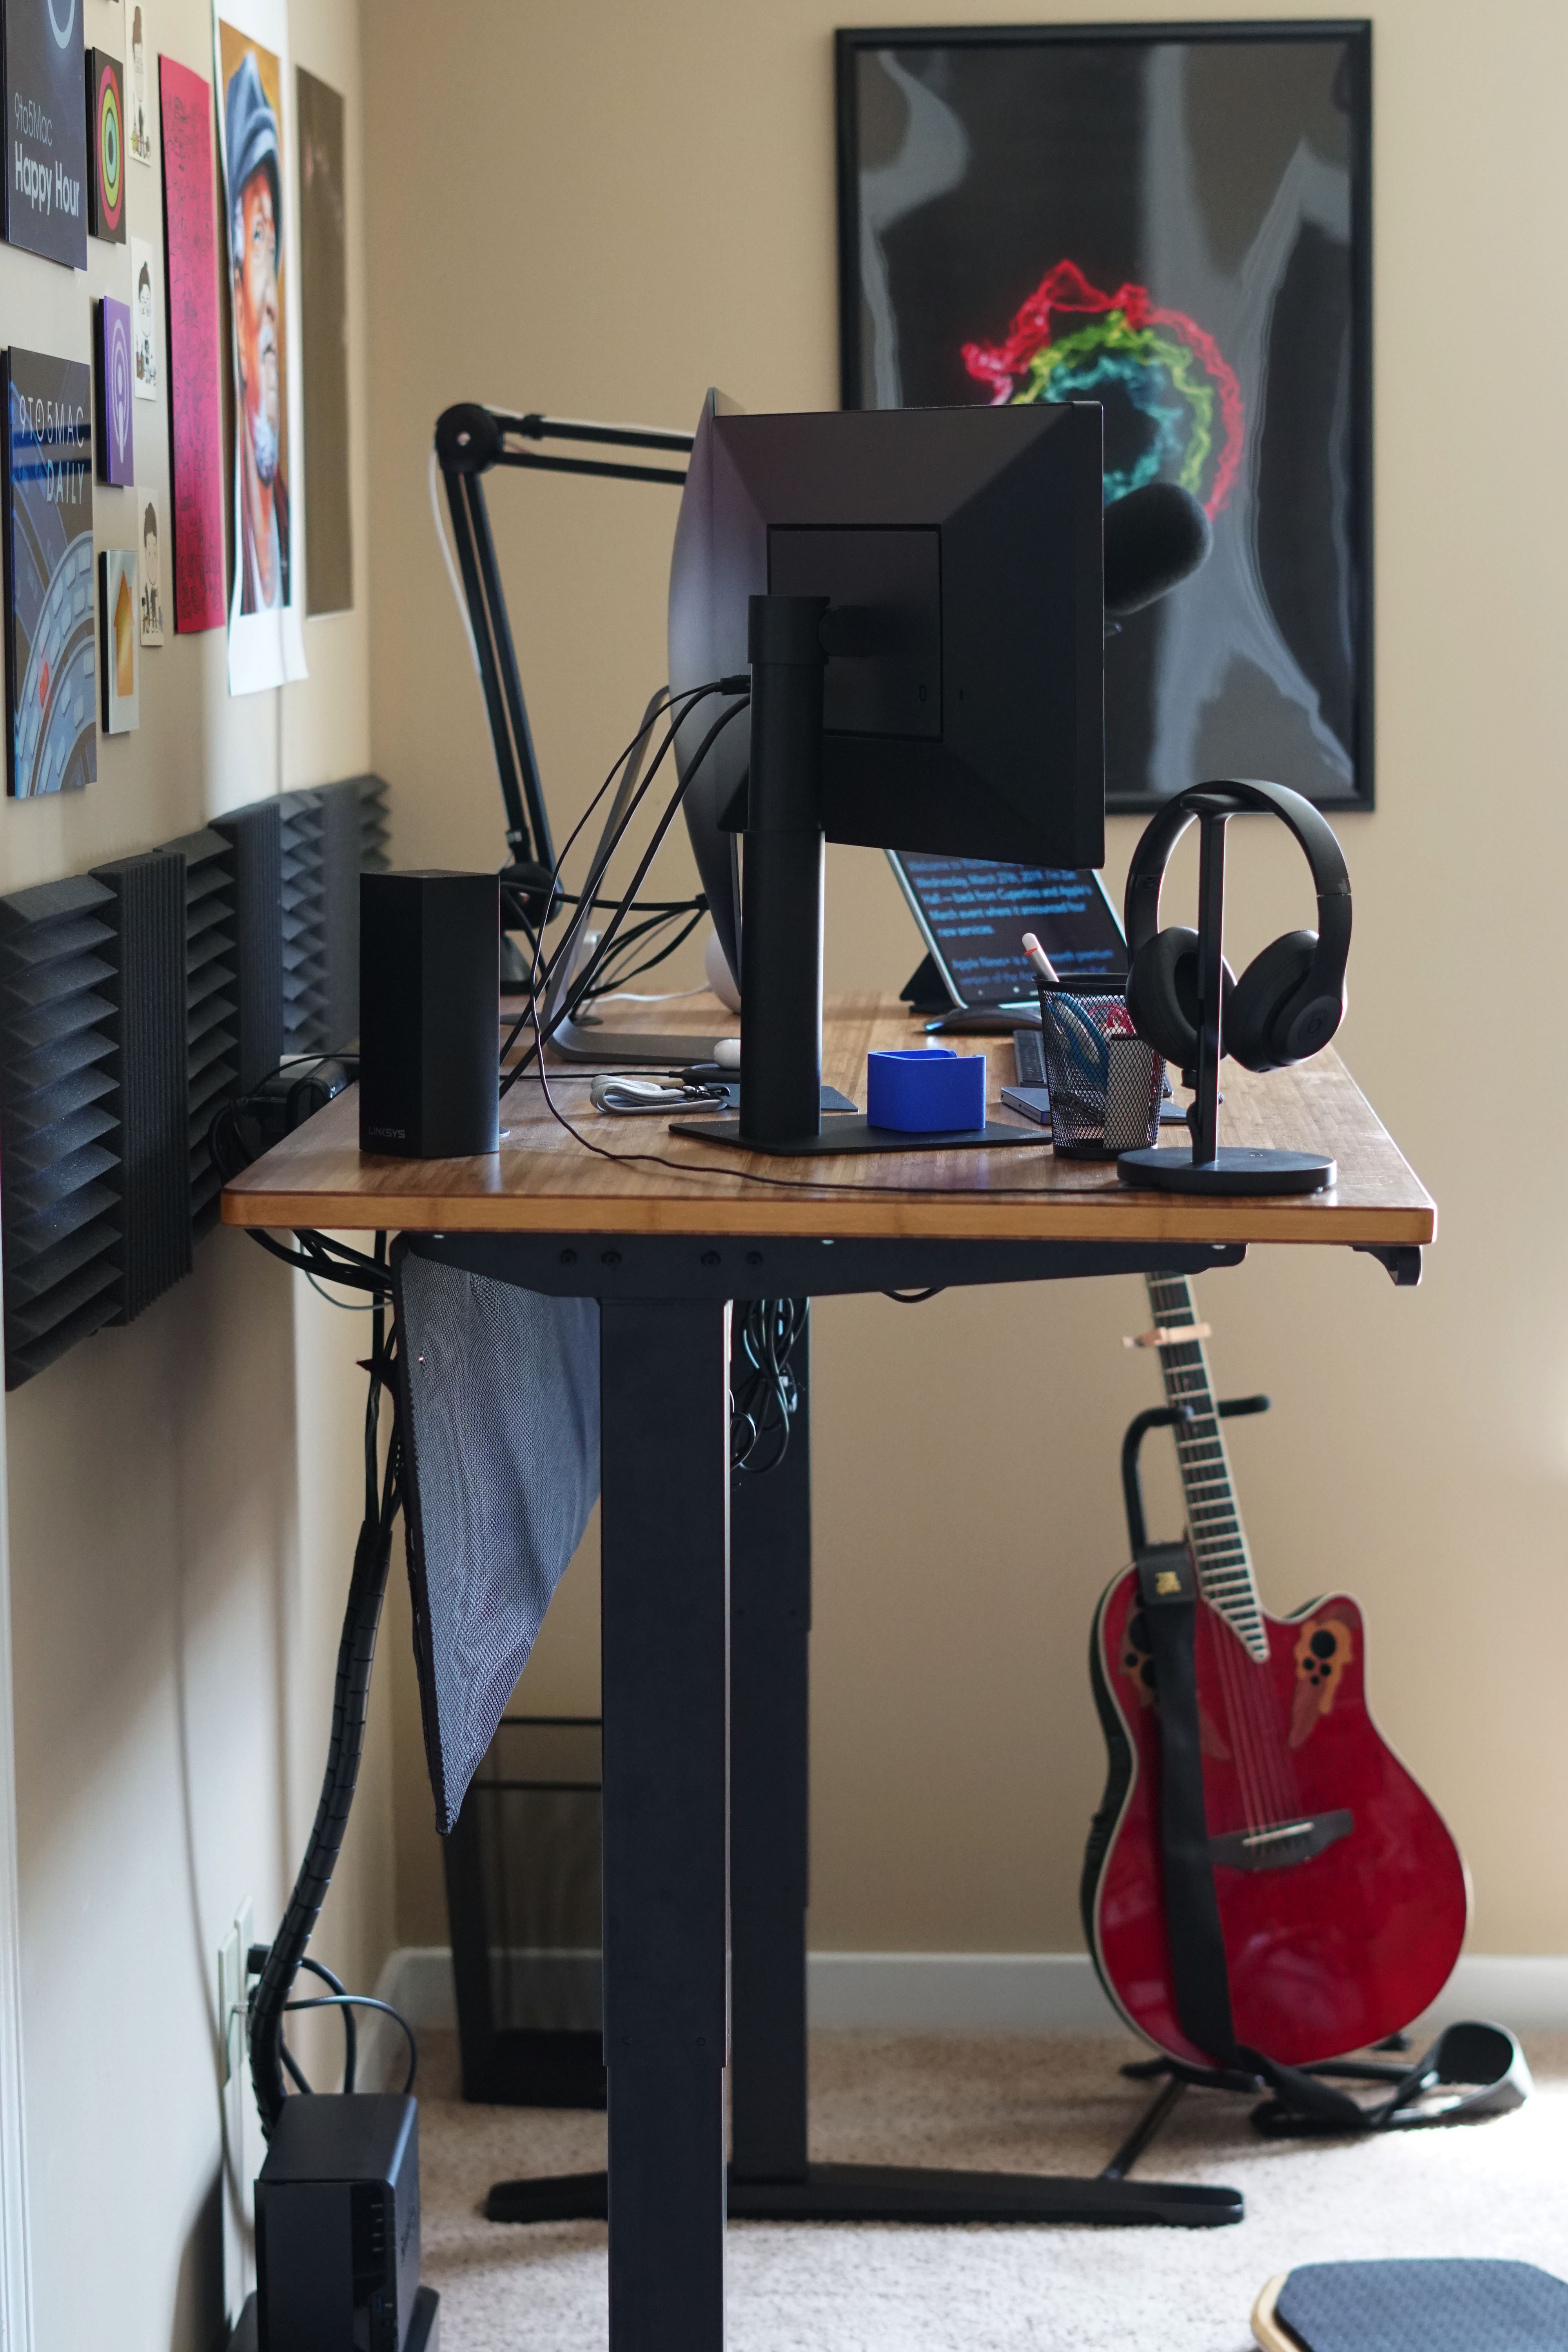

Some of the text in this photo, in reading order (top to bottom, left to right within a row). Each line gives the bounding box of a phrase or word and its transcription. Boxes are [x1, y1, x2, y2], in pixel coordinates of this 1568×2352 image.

[15, 93, 53, 147] 9to5Mac
[15, 141, 80, 217] Happy Hour
[20, 395, 84, 448] 9TO5MAC
[47, 459, 84, 505] DAILY
[367, 1126, 406, 1139] LINKSYS
